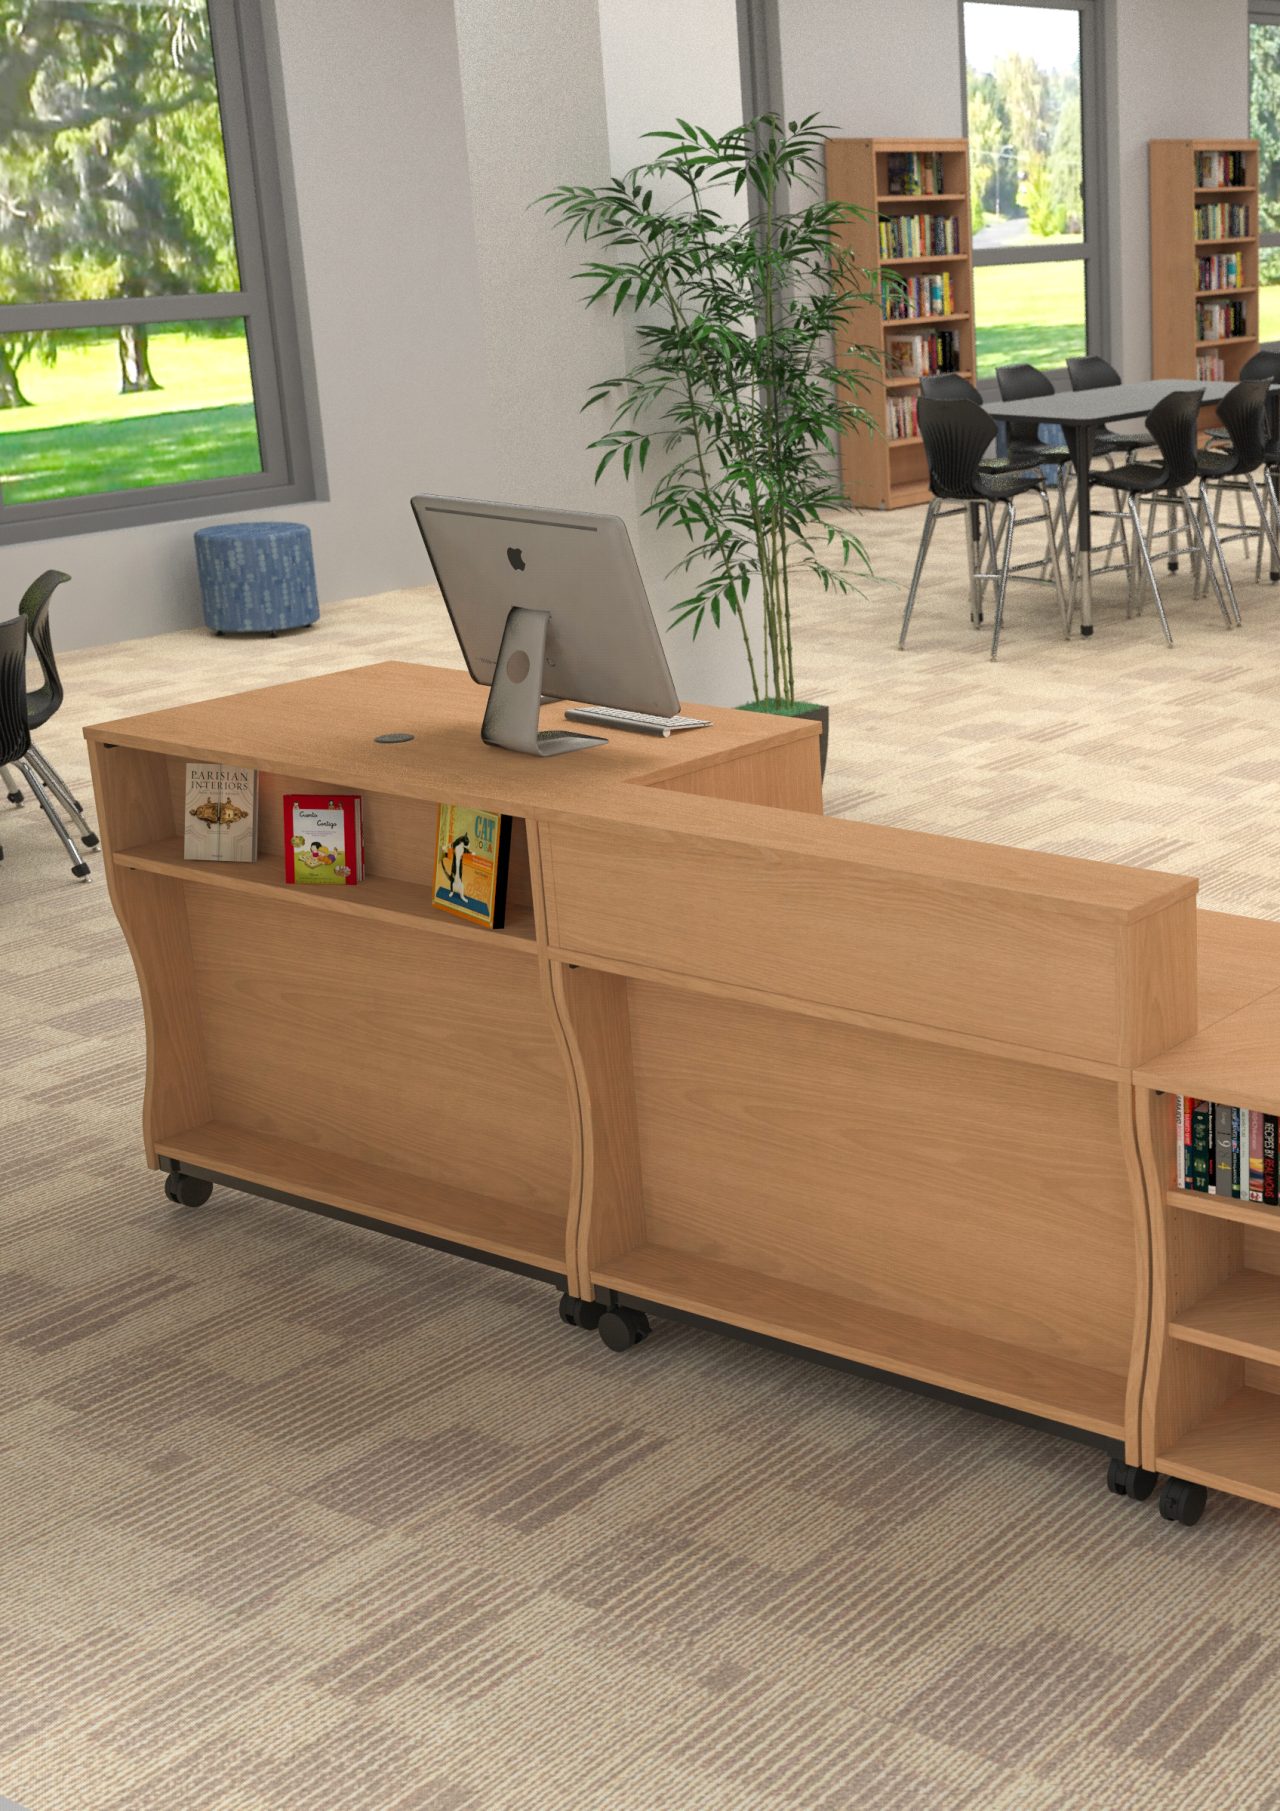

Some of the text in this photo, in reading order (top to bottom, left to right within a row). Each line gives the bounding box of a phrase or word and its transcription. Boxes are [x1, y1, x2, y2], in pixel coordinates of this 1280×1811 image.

[191, 770, 249, 782] PARISIAN
[191, 781, 249, 791] INTERIORS
[475, 815, 496, 843] CAT
[1263, 1122, 1275, 1149] RECIPES
[1263, 1149, 1274, 1159] BY
